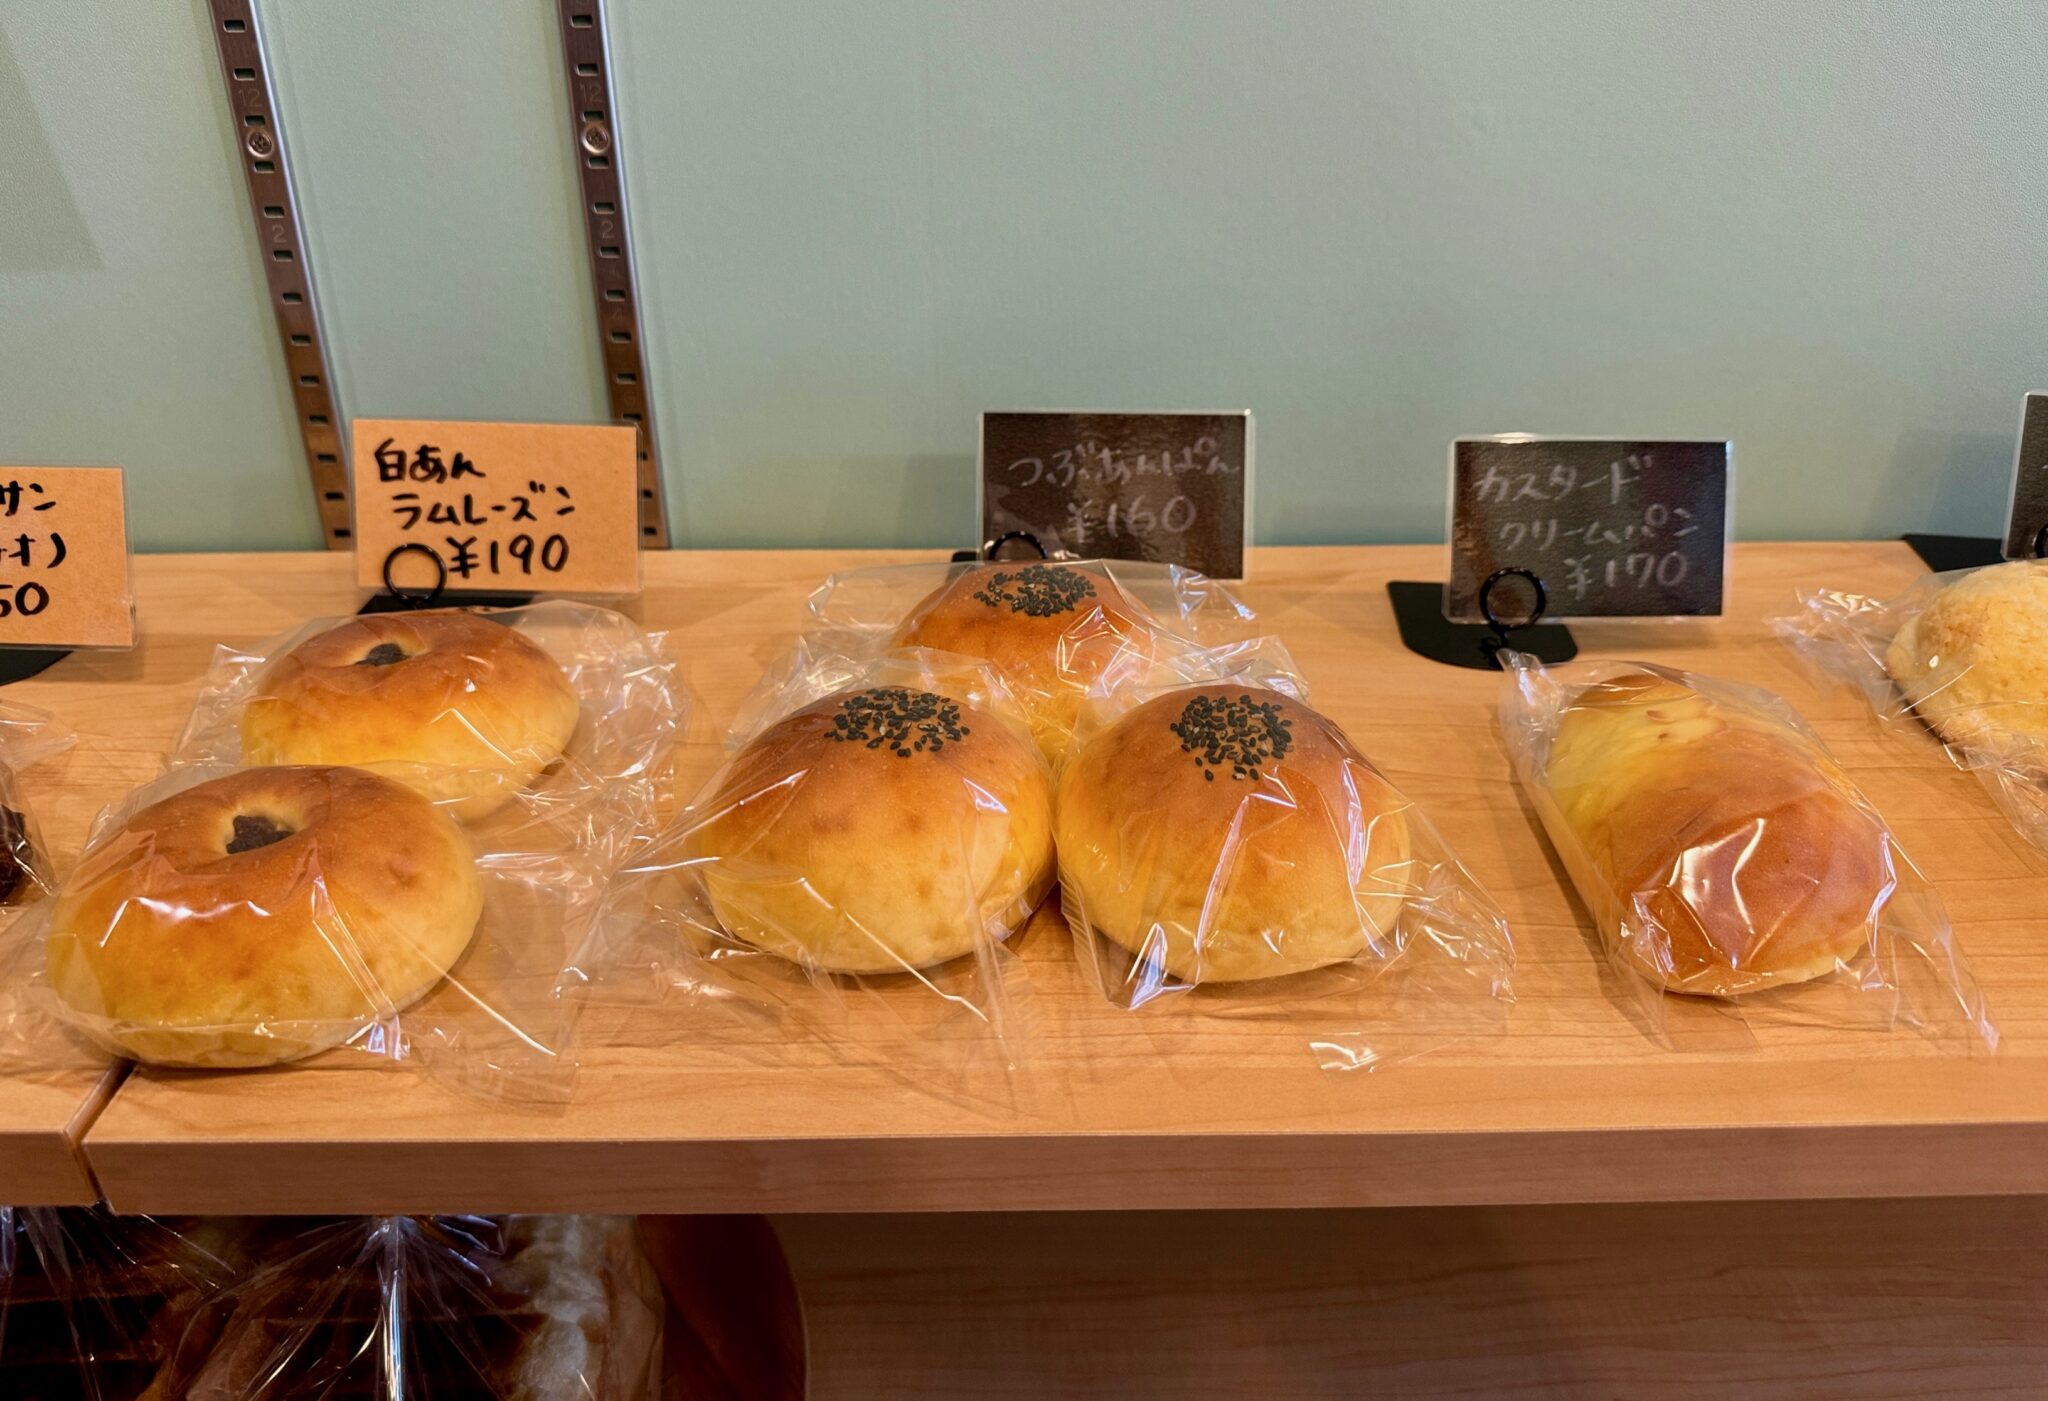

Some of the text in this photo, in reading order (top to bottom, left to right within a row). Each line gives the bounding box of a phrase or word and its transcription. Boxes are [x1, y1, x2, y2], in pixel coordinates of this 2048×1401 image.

[374, 437, 486, 484] 白あん
[1471, 454, 1654, 505] カスタード
[392, 480, 576, 530] ラムレーズン
[1066, 494, 1197, 545] ¥160
[1499, 503, 1700, 552] クリームパン
[446, 533, 570, 579] ¥190
[1563, 550, 1688, 601] ¥170
